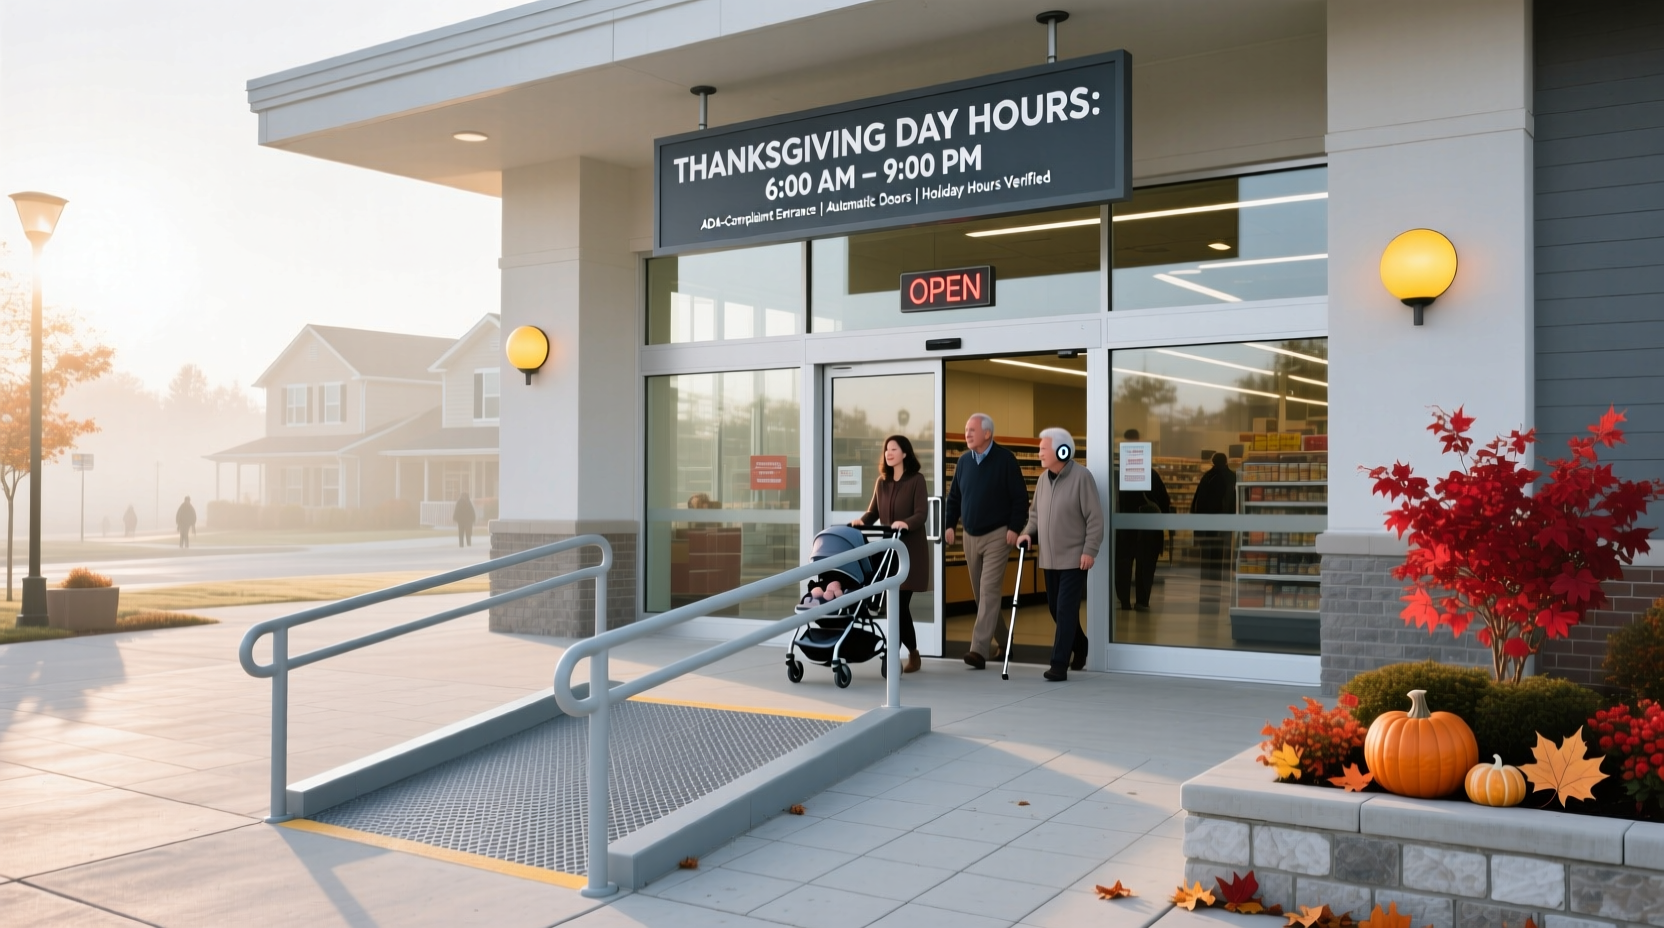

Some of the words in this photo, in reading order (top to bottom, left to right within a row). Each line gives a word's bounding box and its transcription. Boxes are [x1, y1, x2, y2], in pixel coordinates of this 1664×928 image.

[673, 122, 886, 184] THANKSGIVING
[896, 108, 959, 148] DAY
[968, 86, 1100, 136] HOURS:
[765, 171, 812, 200] 6:00
[817, 164, 855, 194] AM
[883, 152, 936, 184] 9:00
[942, 144, 982, 175] PM
[879, 192, 912, 206] Doors
[922, 183, 965, 199] Holiday
[967, 179, 1002, 194] Hours
[1003, 169, 1051, 189] Verified
[909, 272, 981, 305] OPEN
